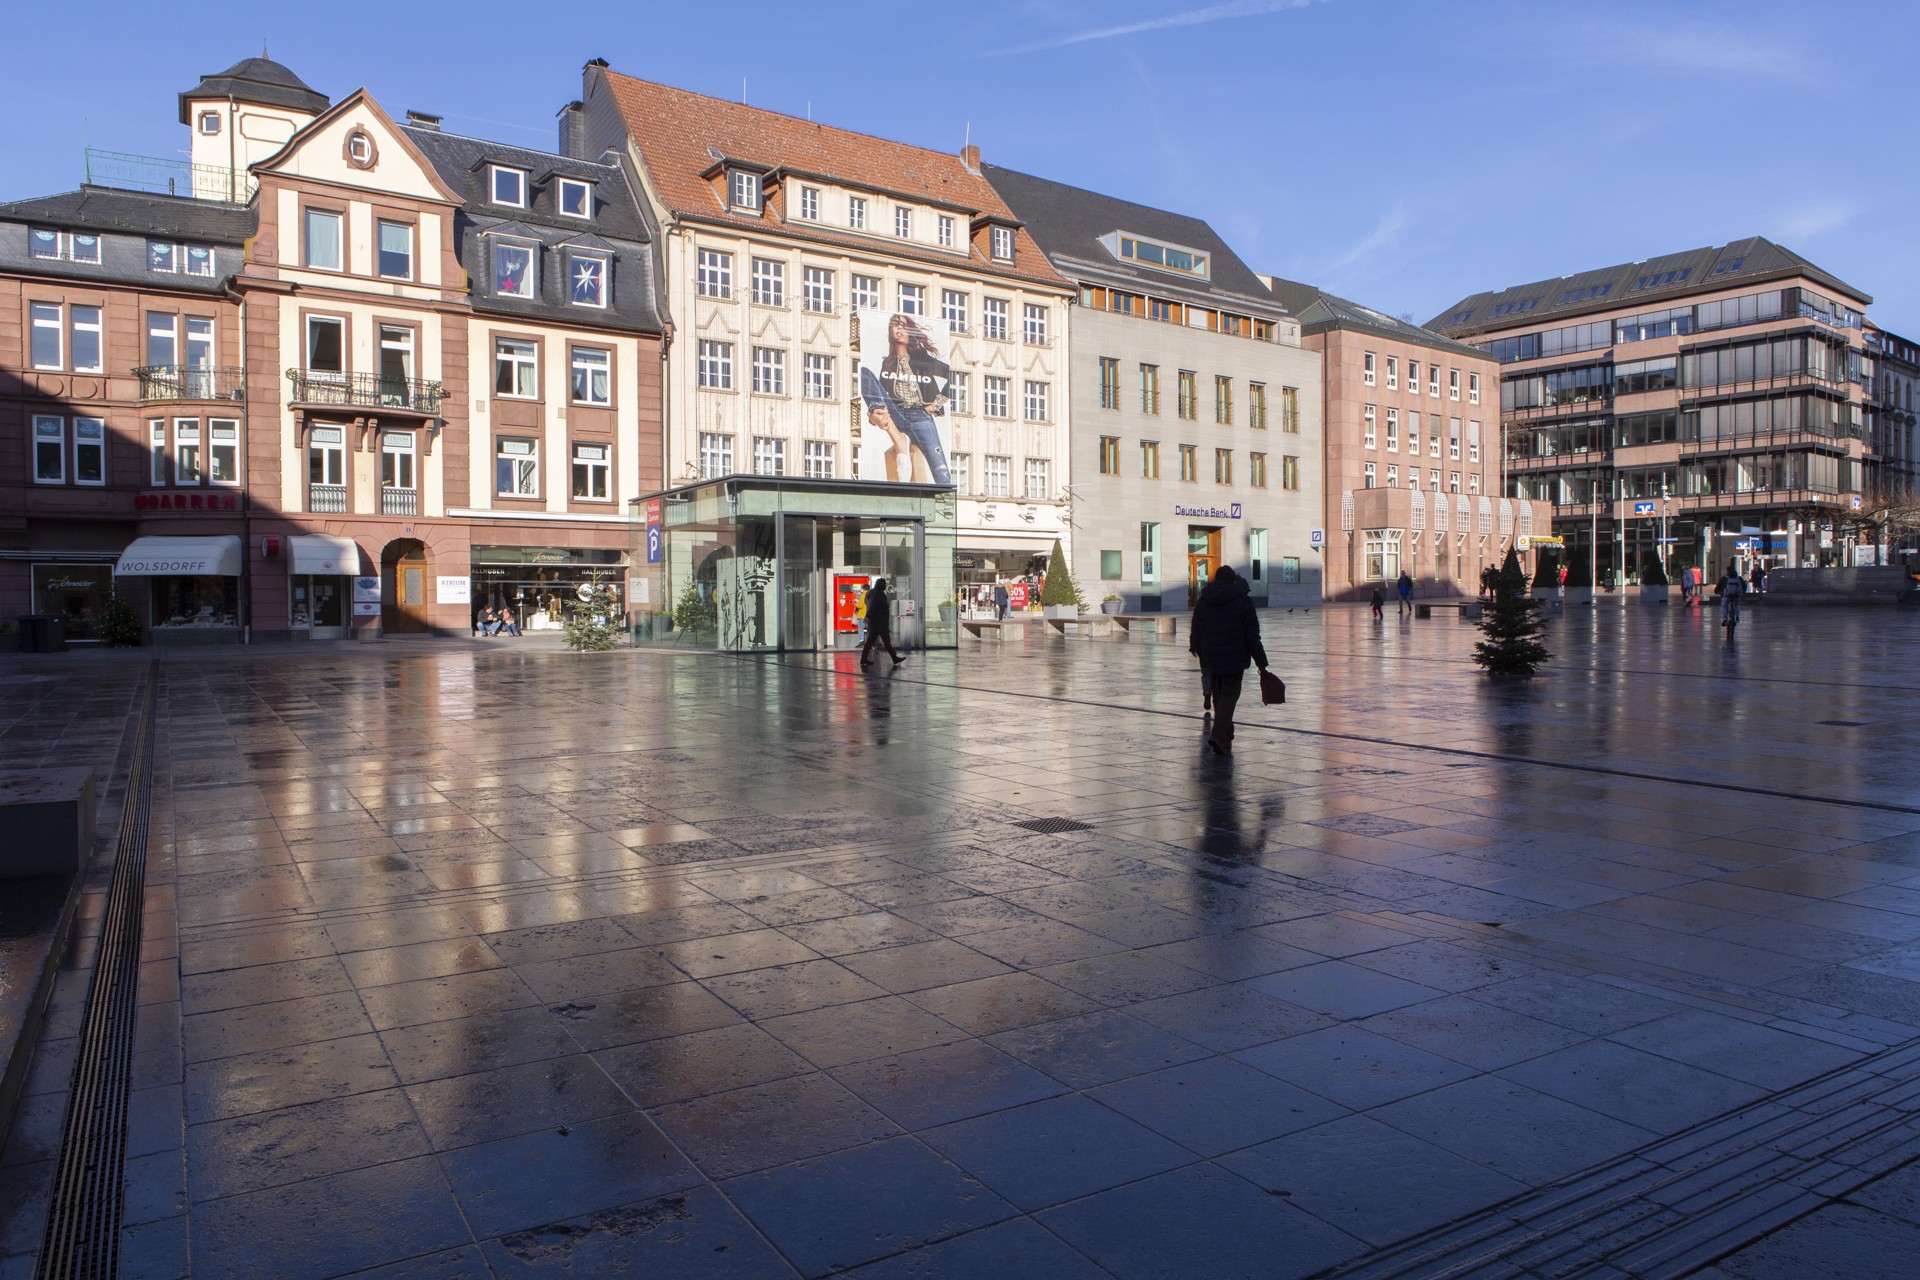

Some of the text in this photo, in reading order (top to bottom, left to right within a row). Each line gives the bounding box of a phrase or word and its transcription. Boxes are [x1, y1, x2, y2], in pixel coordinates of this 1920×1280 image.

[881, 371, 931, 383] CAMBIO
[1175, 505, 1228, 518] Deutsche Bank
[122, 562, 205, 571] WOLSDORFF
